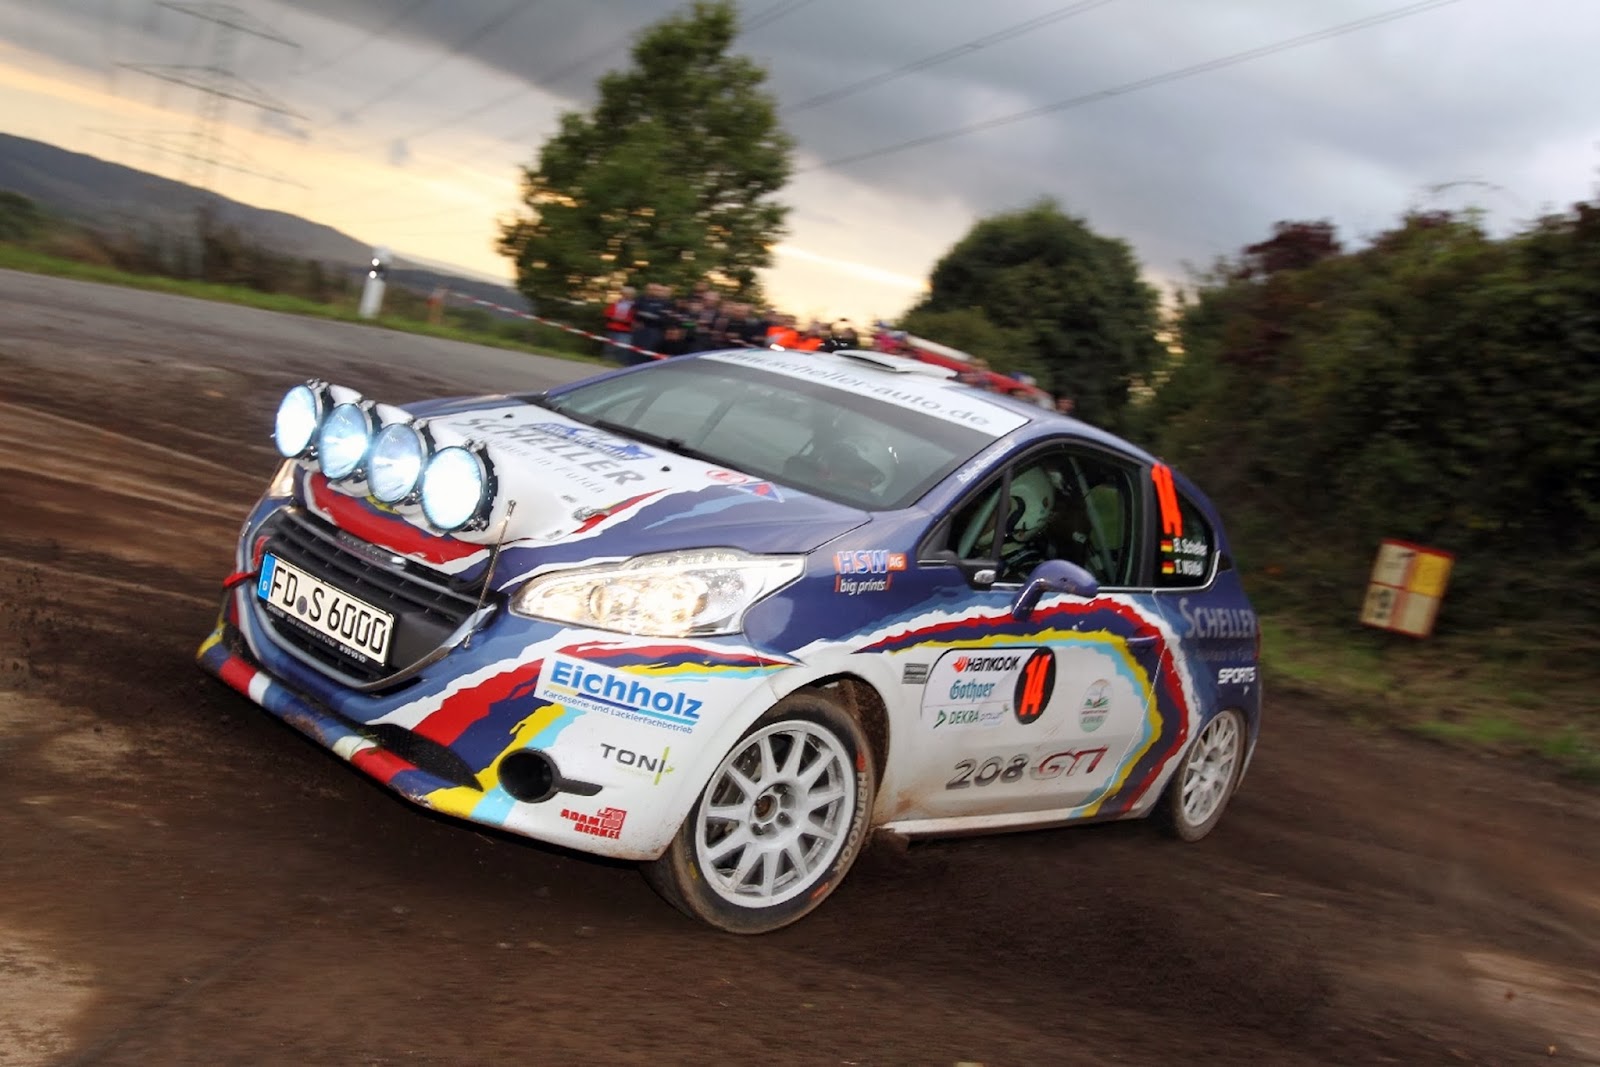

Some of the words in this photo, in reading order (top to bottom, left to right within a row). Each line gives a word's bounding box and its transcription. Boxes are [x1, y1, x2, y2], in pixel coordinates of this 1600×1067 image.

[449, 418, 645, 486] SCHELLER
[889, 555, 904, 567] AG
[840, 578, 857, 596] big
[857, 577, 887, 596] prints
[270, 566, 299, 607] FD
[308, 587, 325, 623] S
[327, 597, 388, 655] 6000
[550, 660, 704, 720] Eichholz
[591, 704, 609, 715] und
[610, 709, 694, 735] Lackierfachbetrieb
[948, 710, 980, 725] DEKRA
[946, 753, 1031, 790] 208
[560, 808, 600, 827] ADAM
